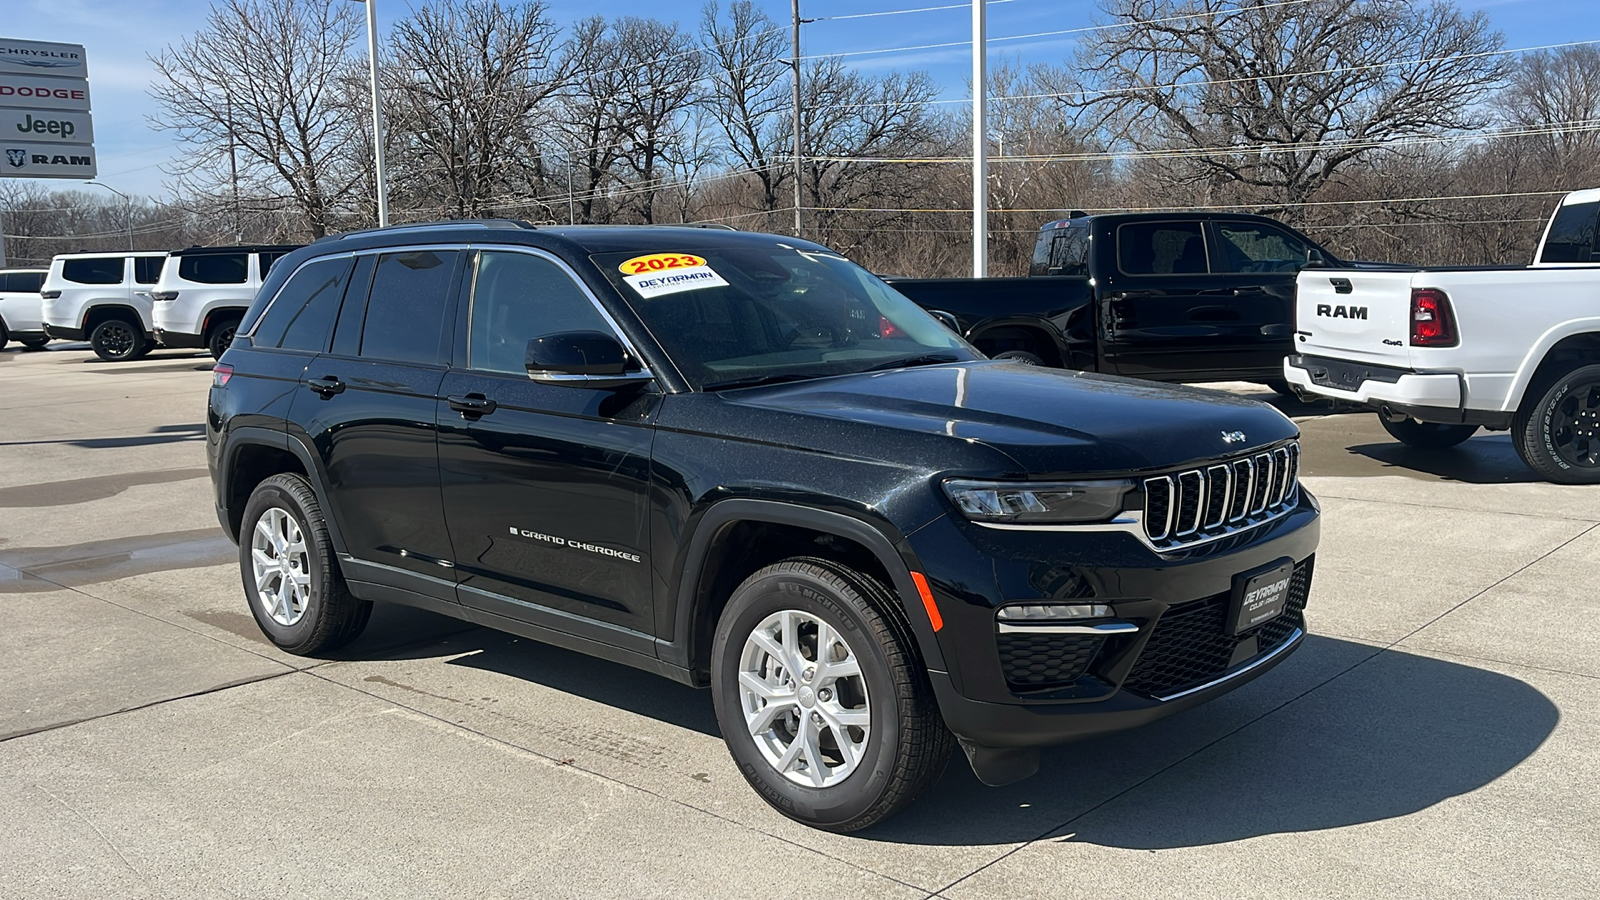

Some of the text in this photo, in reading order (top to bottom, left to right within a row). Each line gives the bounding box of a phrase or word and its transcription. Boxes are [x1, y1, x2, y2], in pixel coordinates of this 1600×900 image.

[0, 86, 85, 100] DODGE
[16, 114, 75, 138] Jeep
[31, 154, 91, 166] RAM
[630, 256, 698, 273] 2023
[639, 272, 713, 288] DEYARMAN
[1317, 304, 1368, 320] RAM
[520, 529, 641, 563] GRAND CHEROKEE
[1243, 577, 1290, 606] DEYARMAN
[802, 588, 856, 630] MICHELIN
[745, 763, 793, 808] MICHELIN
